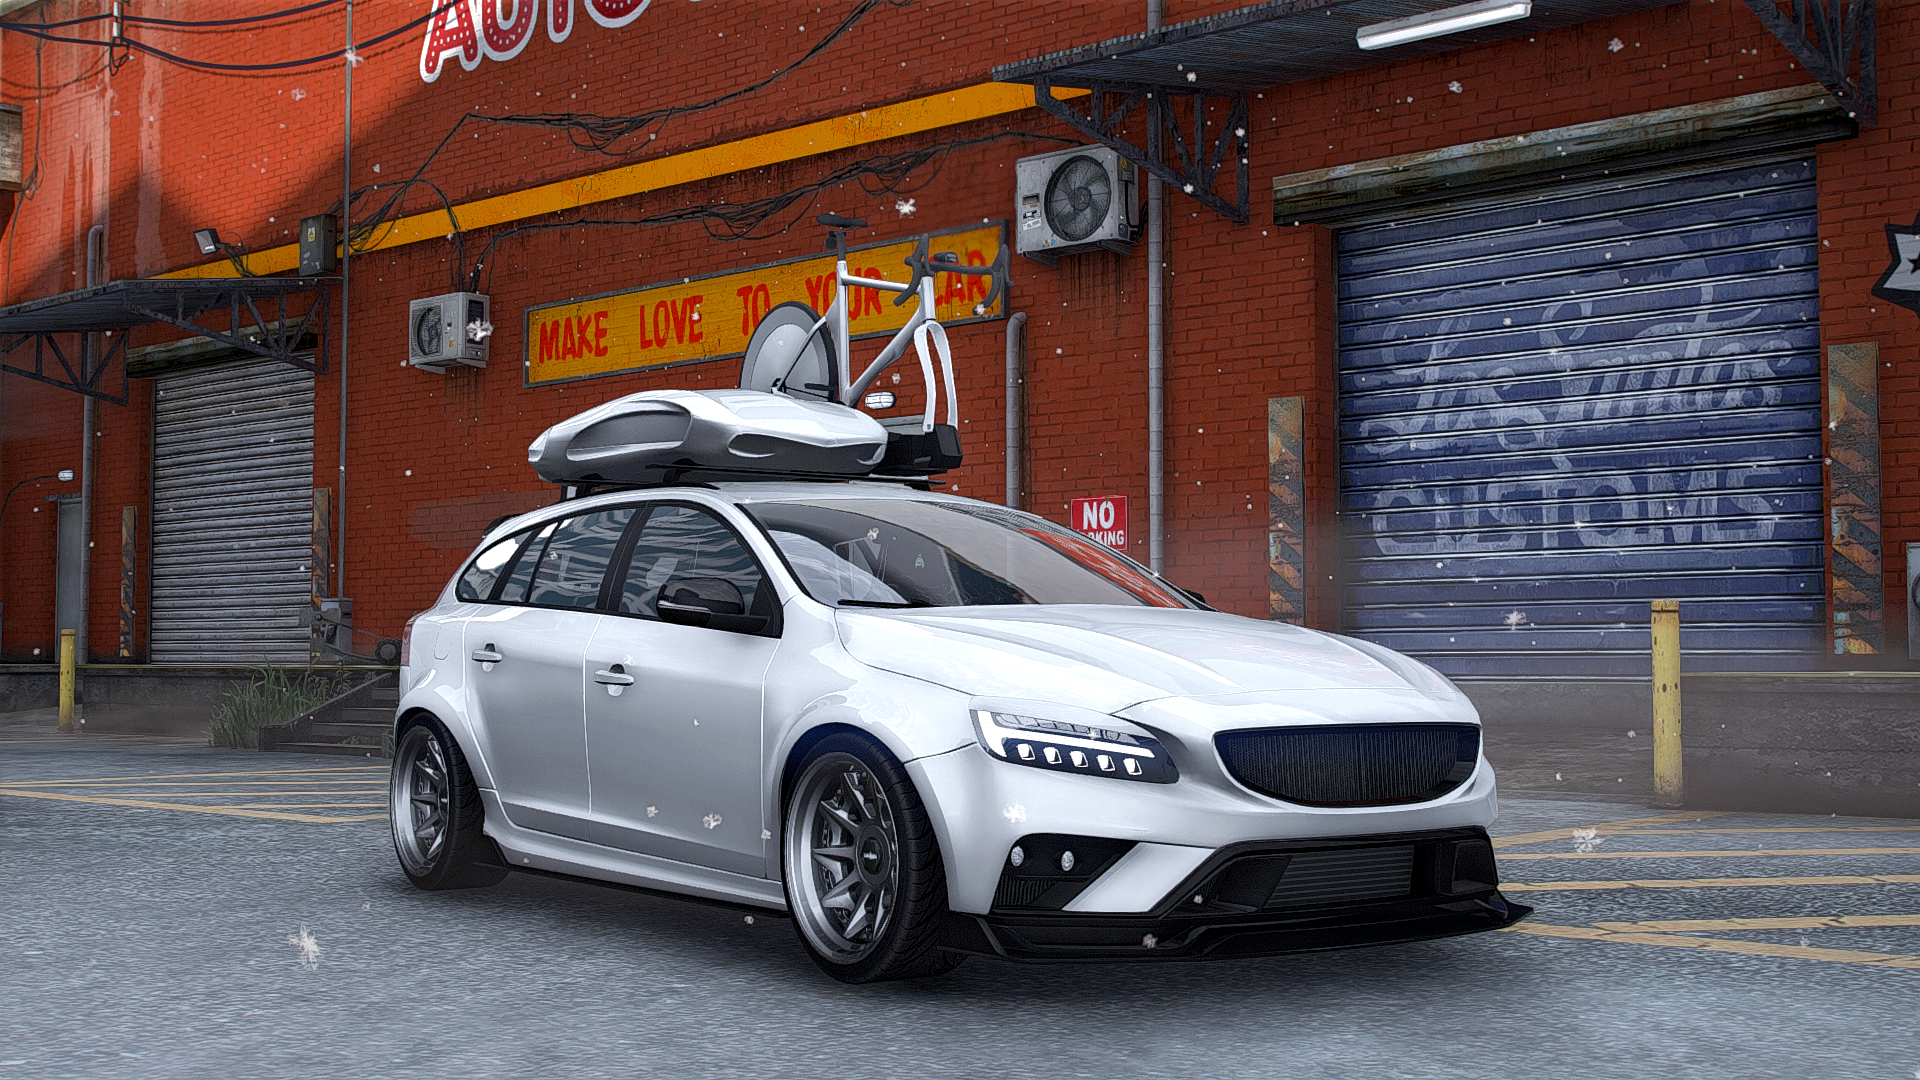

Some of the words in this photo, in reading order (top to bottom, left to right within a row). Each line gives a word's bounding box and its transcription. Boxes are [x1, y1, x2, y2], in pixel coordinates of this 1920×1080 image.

[419, 0, 652, 83] AU
[539, 310, 609, 364] MAKE
[639, 295, 704, 350] LOVE
[737, 283, 770, 336] TO
[805, 267, 883, 320] YOUR
[933, 249, 988, 306] AR
[1082, 500, 1115, 530] NO
[1088, 529, 1125, 546] KING
[1373, 455, 1777, 554] CUSTOMS
